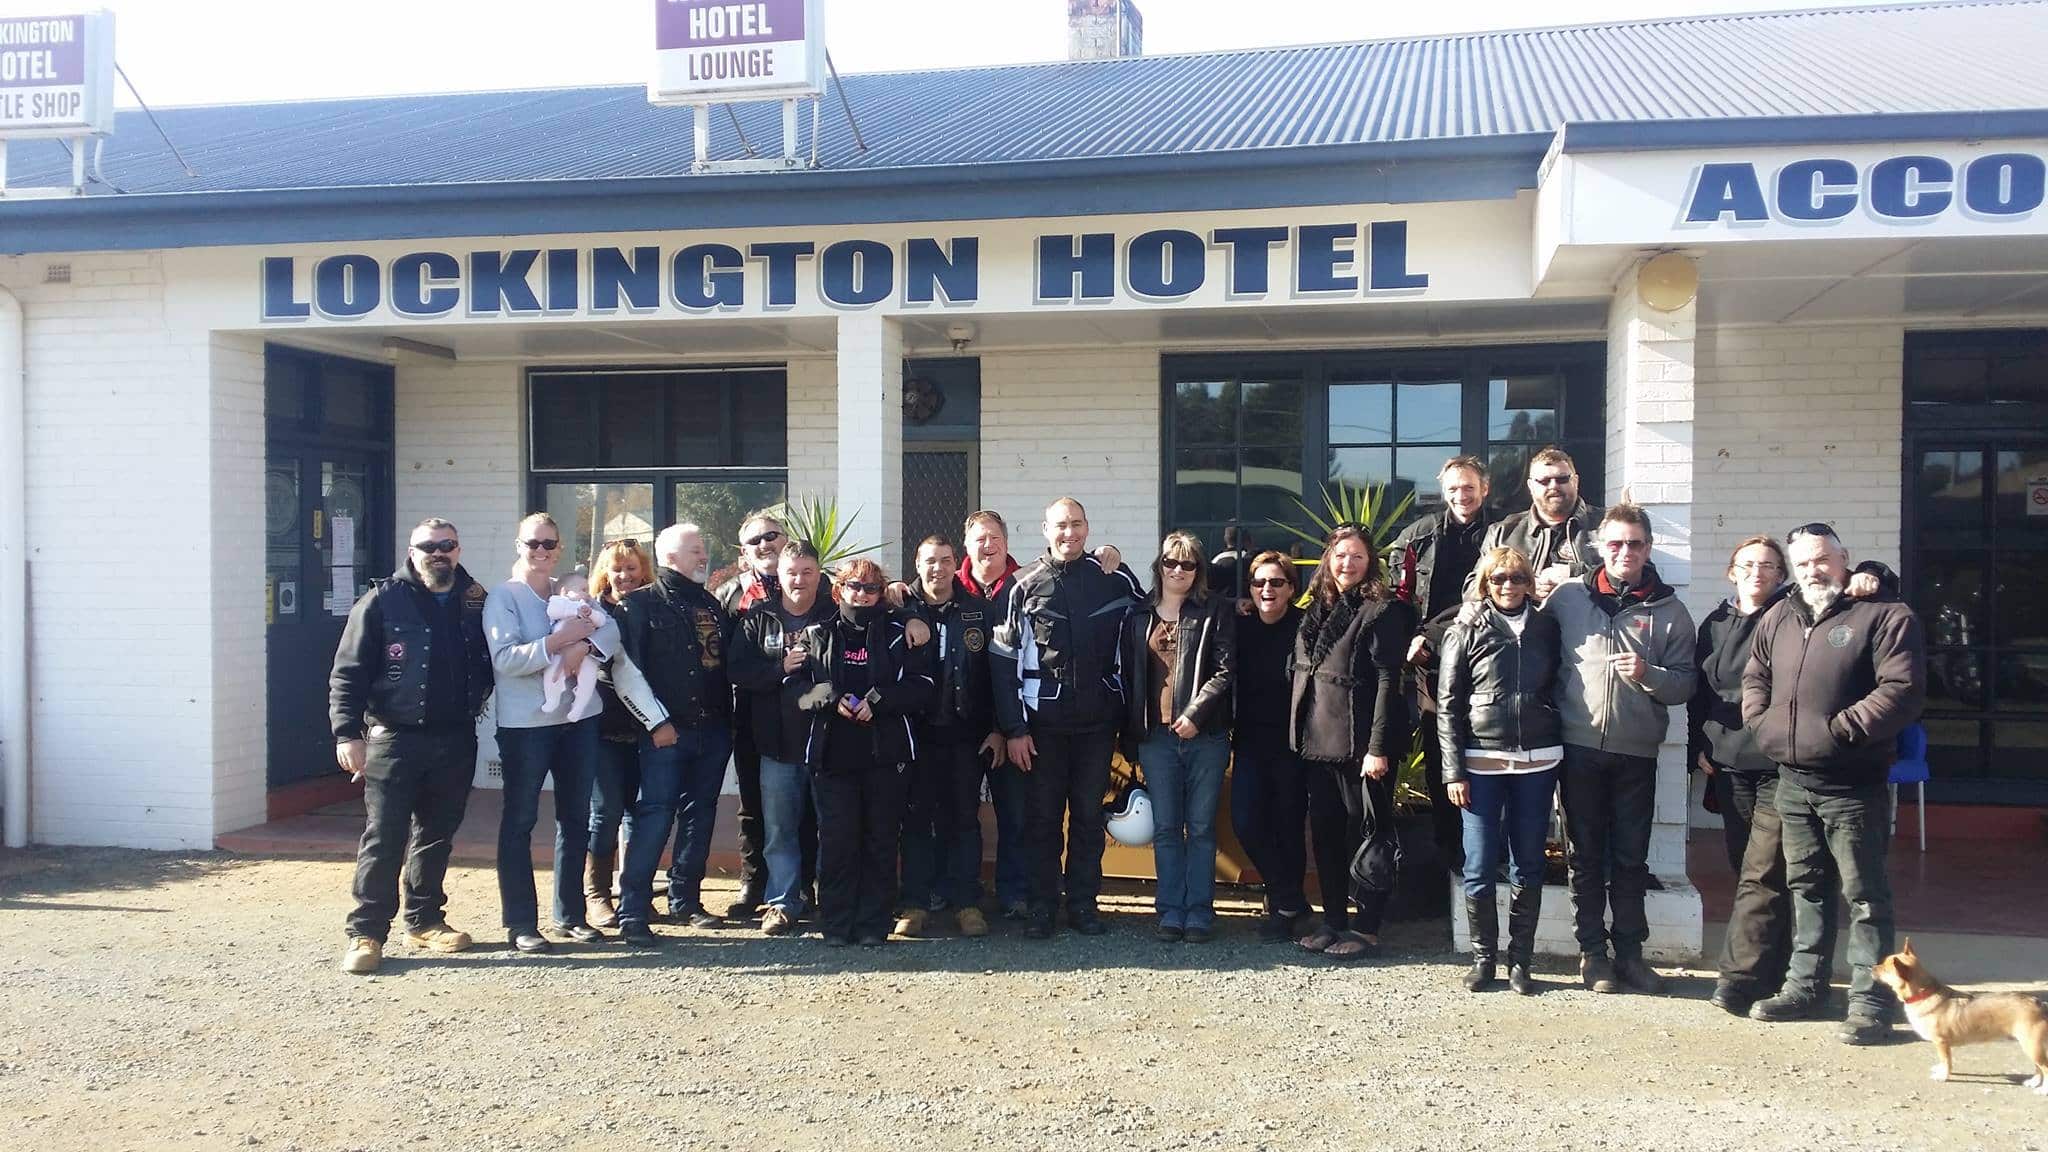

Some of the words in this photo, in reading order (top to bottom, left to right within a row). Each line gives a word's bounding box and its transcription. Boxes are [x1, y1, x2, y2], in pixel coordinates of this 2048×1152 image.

[689, 3, 773, 40] HOTEL
[1, 49, 57, 81] OTEL
[688, 48, 774, 81] LOUNGE
[31, 91, 81, 118] SHOP
[1676, 152, 2047, 227] ACCO
[261, 236, 979, 321] LOCKINGTON
[1034, 220, 1429, 303] HOTEL
